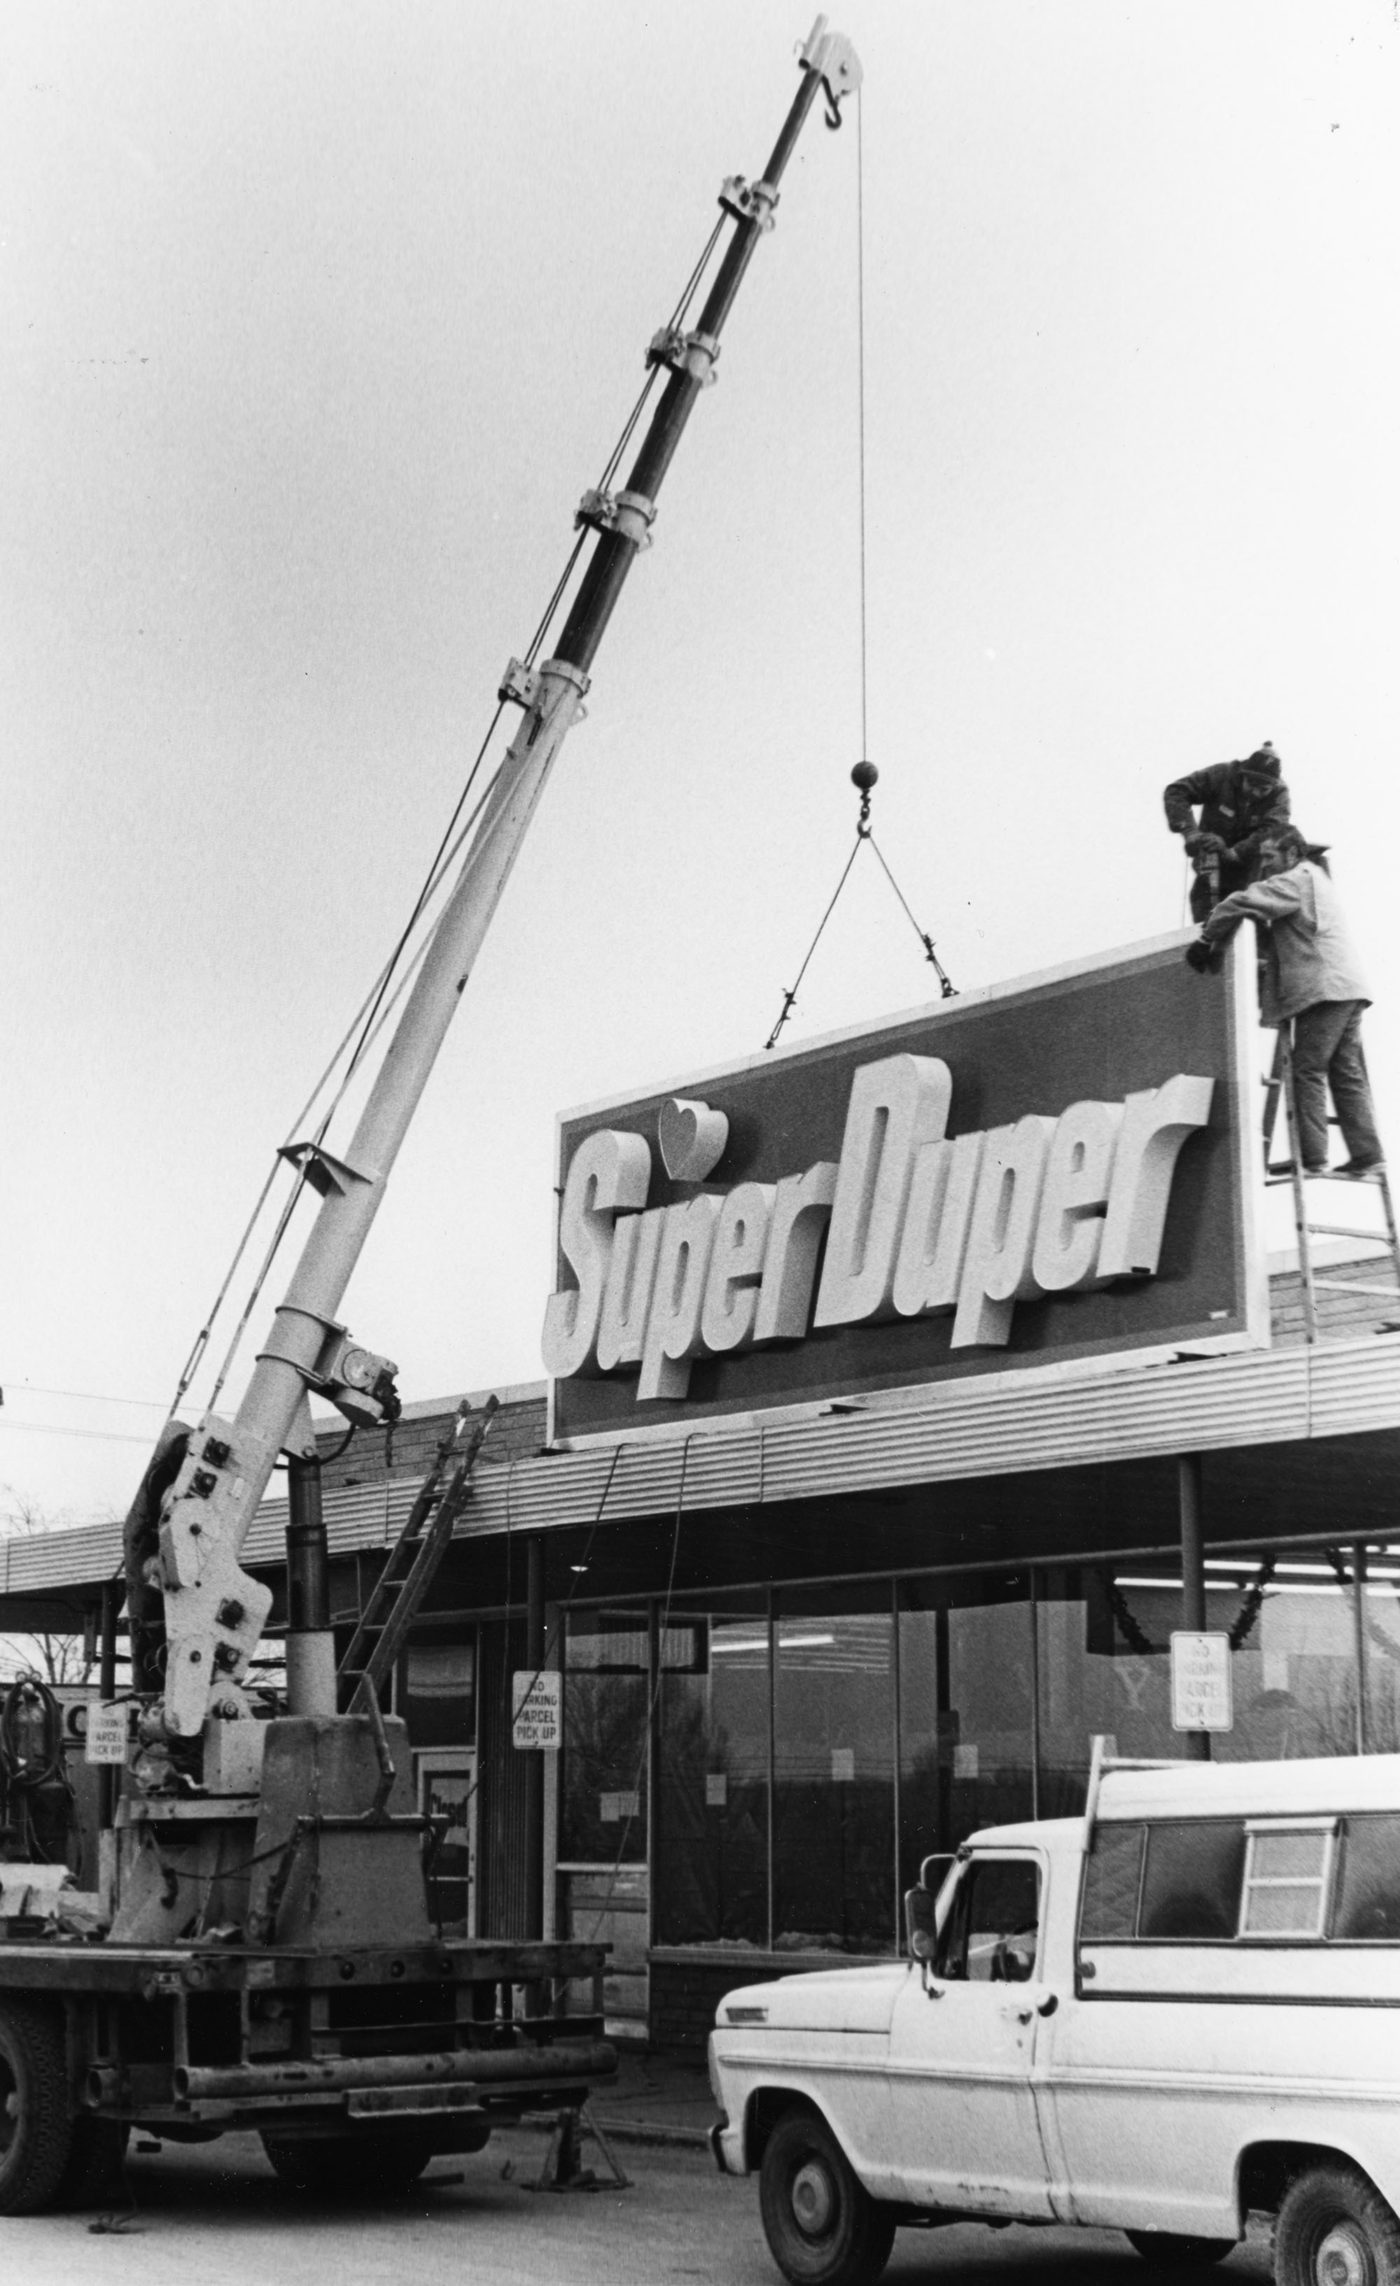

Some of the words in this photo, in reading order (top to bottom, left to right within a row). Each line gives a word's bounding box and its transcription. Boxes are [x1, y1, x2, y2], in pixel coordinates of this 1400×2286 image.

[541, 1128, 841, 1400] Super
[812, 1053, 1214, 1348] Duper
[518, 1710, 556, 1724] PARCEL
[92, 1731, 122, 1742] ARCEL
[517, 1726, 539, 1740] PICK
[543, 1726, 557, 1740] UP
